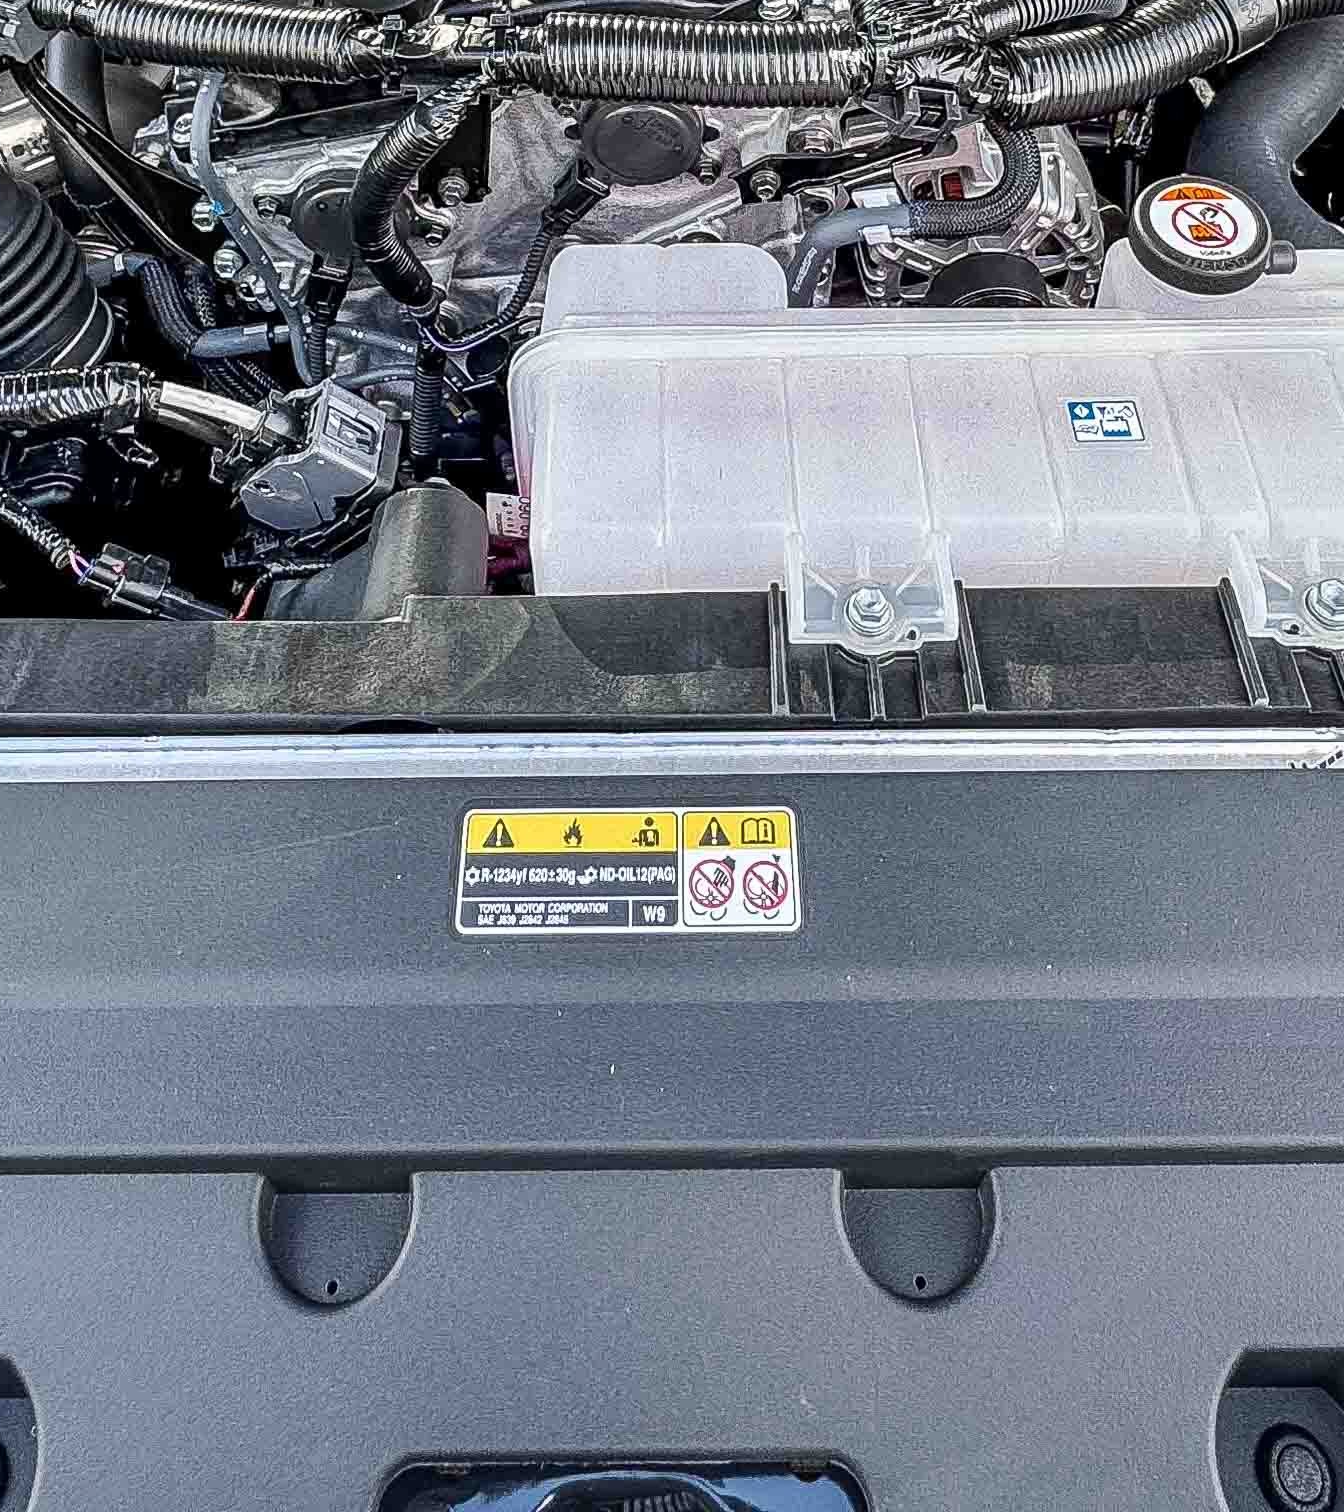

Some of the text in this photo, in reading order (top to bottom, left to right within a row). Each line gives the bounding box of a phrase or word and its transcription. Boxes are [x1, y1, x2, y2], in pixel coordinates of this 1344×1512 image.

[480, 866, 676, 886] R-1234yf 620±30g ND-OIL12(PAG)
[478, 902, 609, 914] TOYOTA MOTOR CORPORATION
[642, 905, 666, 922] W9
